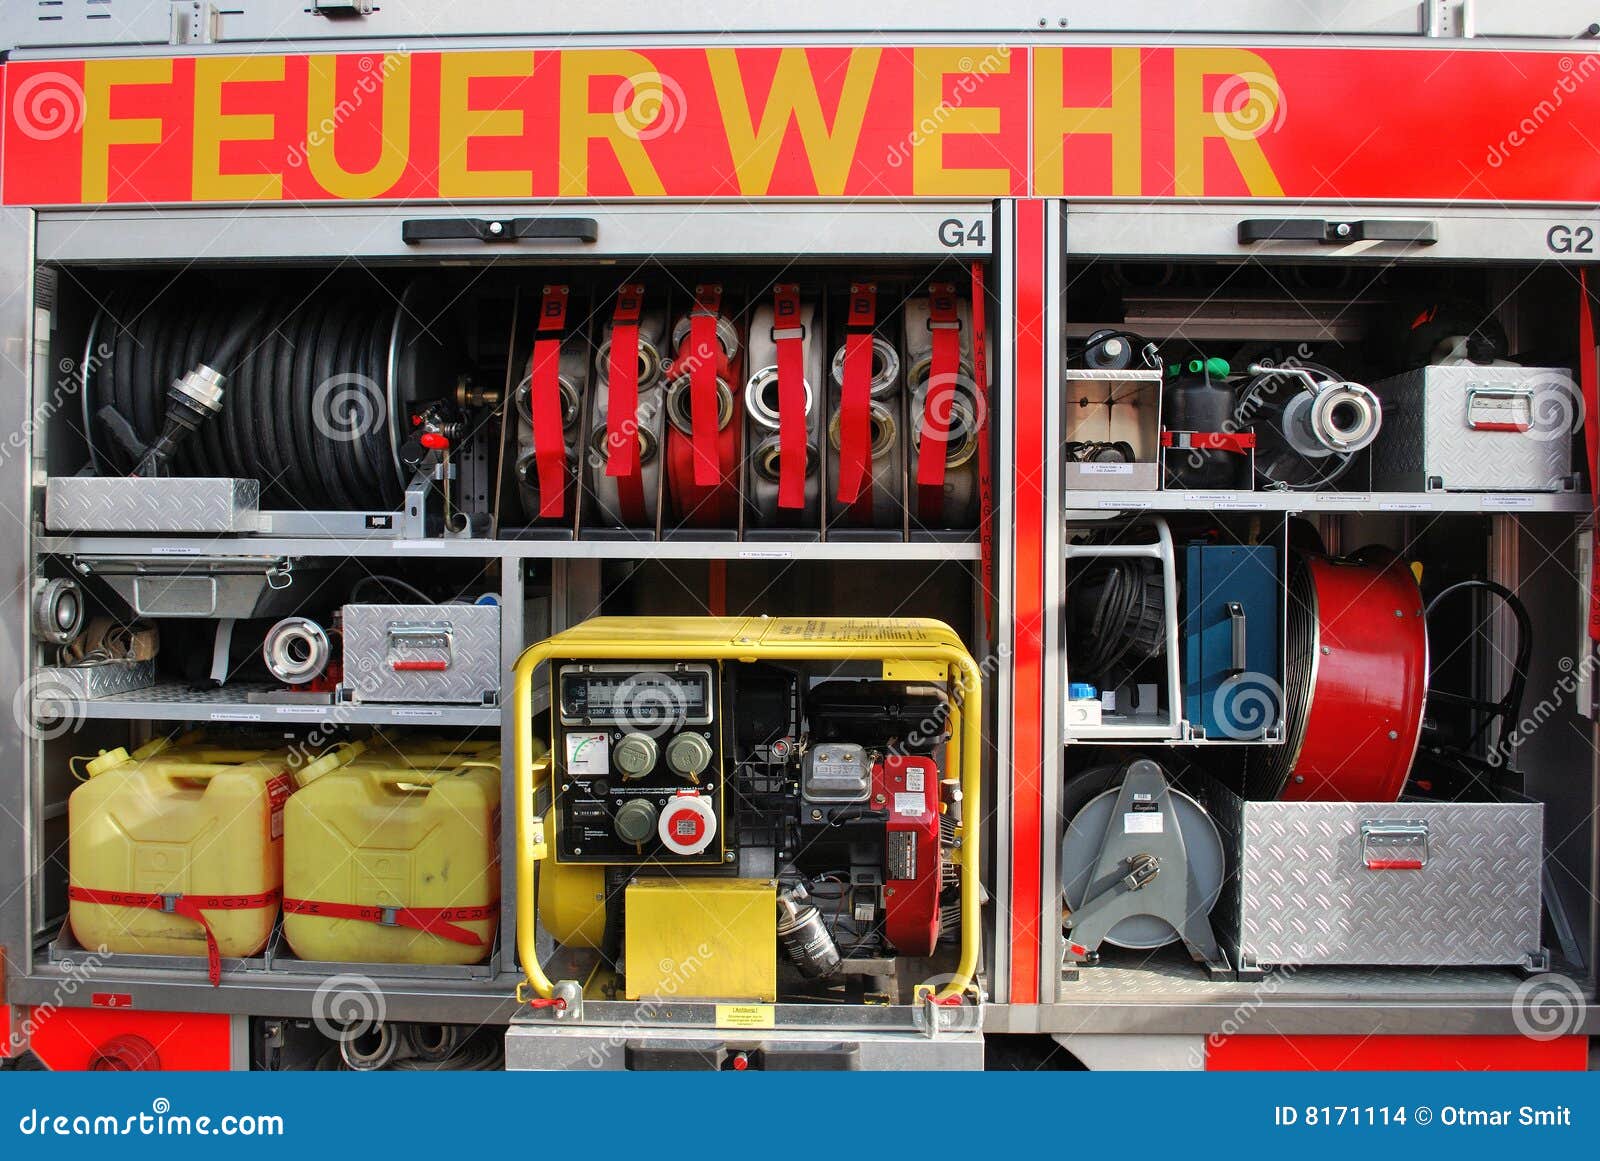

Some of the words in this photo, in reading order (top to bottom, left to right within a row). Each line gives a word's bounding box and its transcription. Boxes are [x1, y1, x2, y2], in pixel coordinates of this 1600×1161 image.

[81, 47, 1285, 202] FEUERWEHR
[939, 219, 986, 247] G4
[1547, 225, 1593, 253] G2
[545, 301, 562, 317] B
[779, 300, 794, 315] B
[854, 299, 870, 314] B
